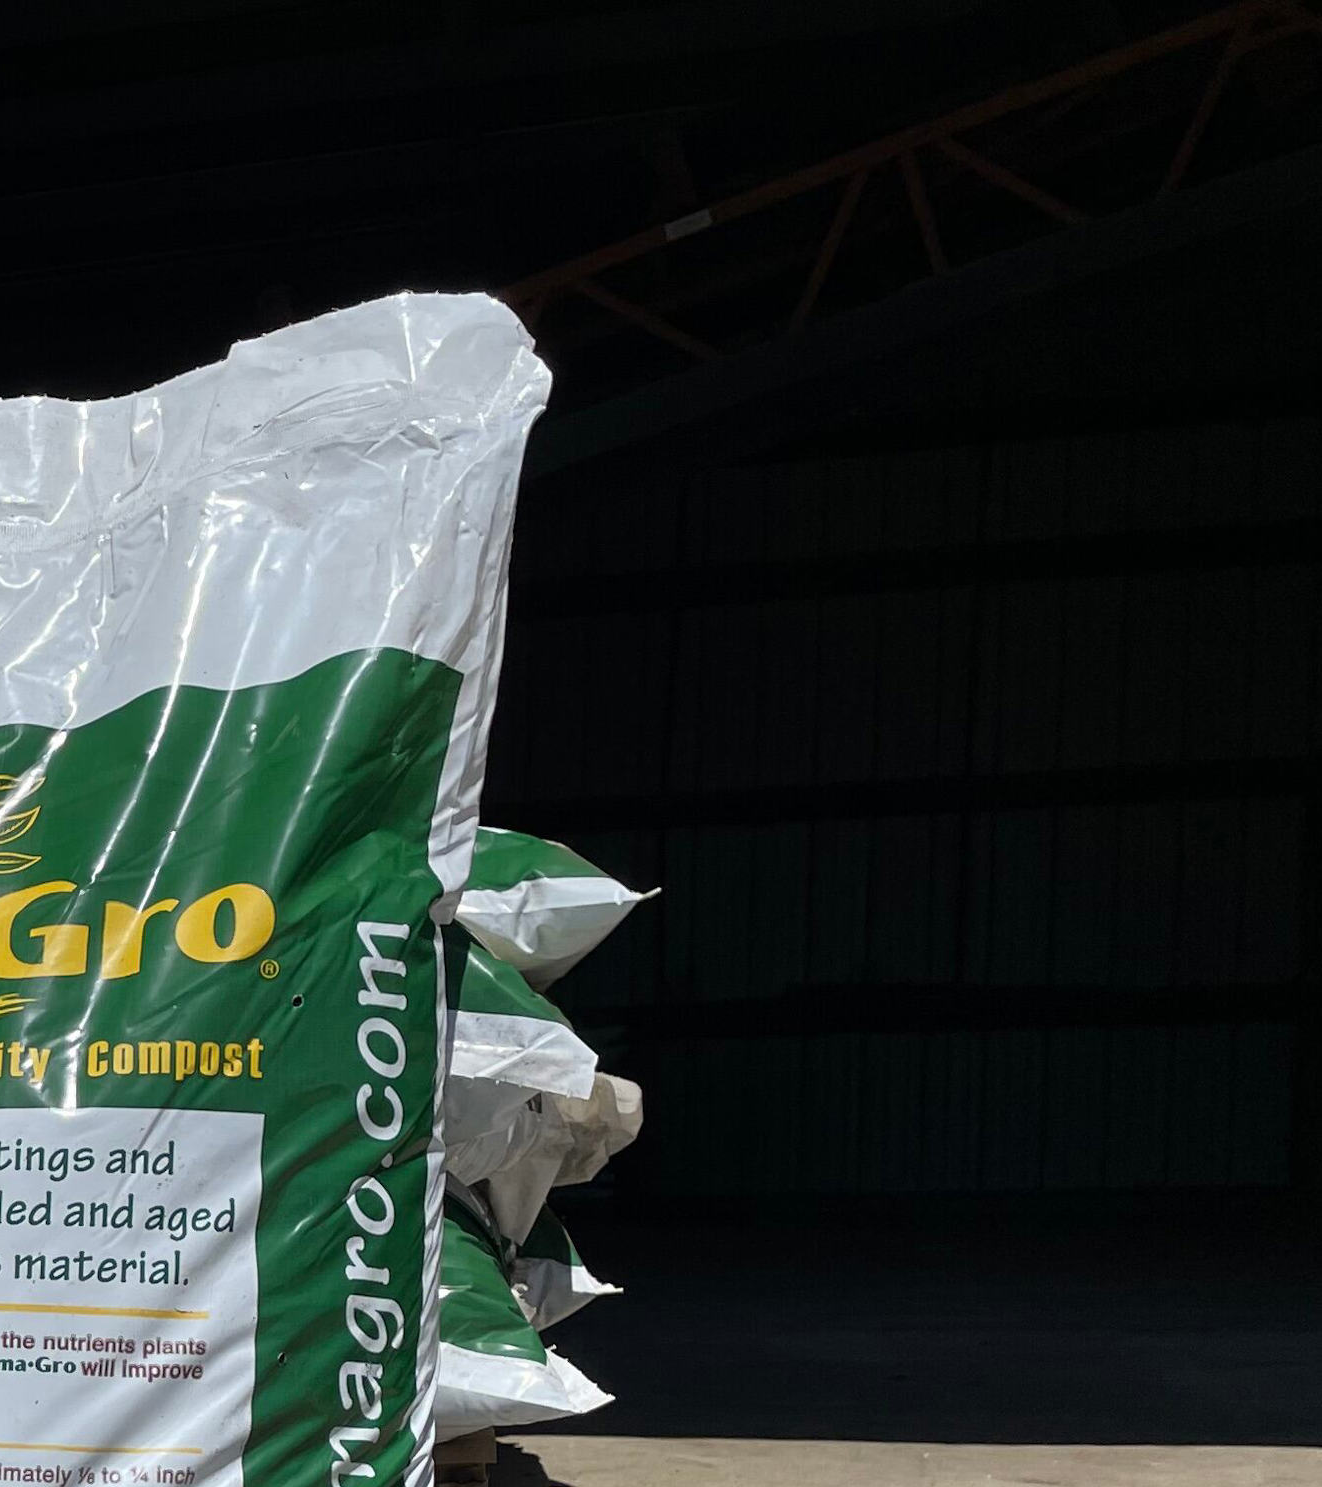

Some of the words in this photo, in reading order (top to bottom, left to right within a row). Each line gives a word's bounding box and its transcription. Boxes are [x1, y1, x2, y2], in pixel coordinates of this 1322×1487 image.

[87, 1038, 265, 1081] Compost
[105, 1141, 175, 1176] and
[64, 1194, 135, 1229] and
[145, 1198, 235, 1241] aged
[15, 1250, 189, 1286] material.
[1, 1331, 35, 1349] the
[43, 1333, 135, 1354] nutrients
[142, 1338, 207, 1357] plants
[81, 1359, 115, 1377] will
[122, 1359, 203, 1382] improve
[102, 1467, 121, 1484] to
[156, 1467, 195, 1485] inch
